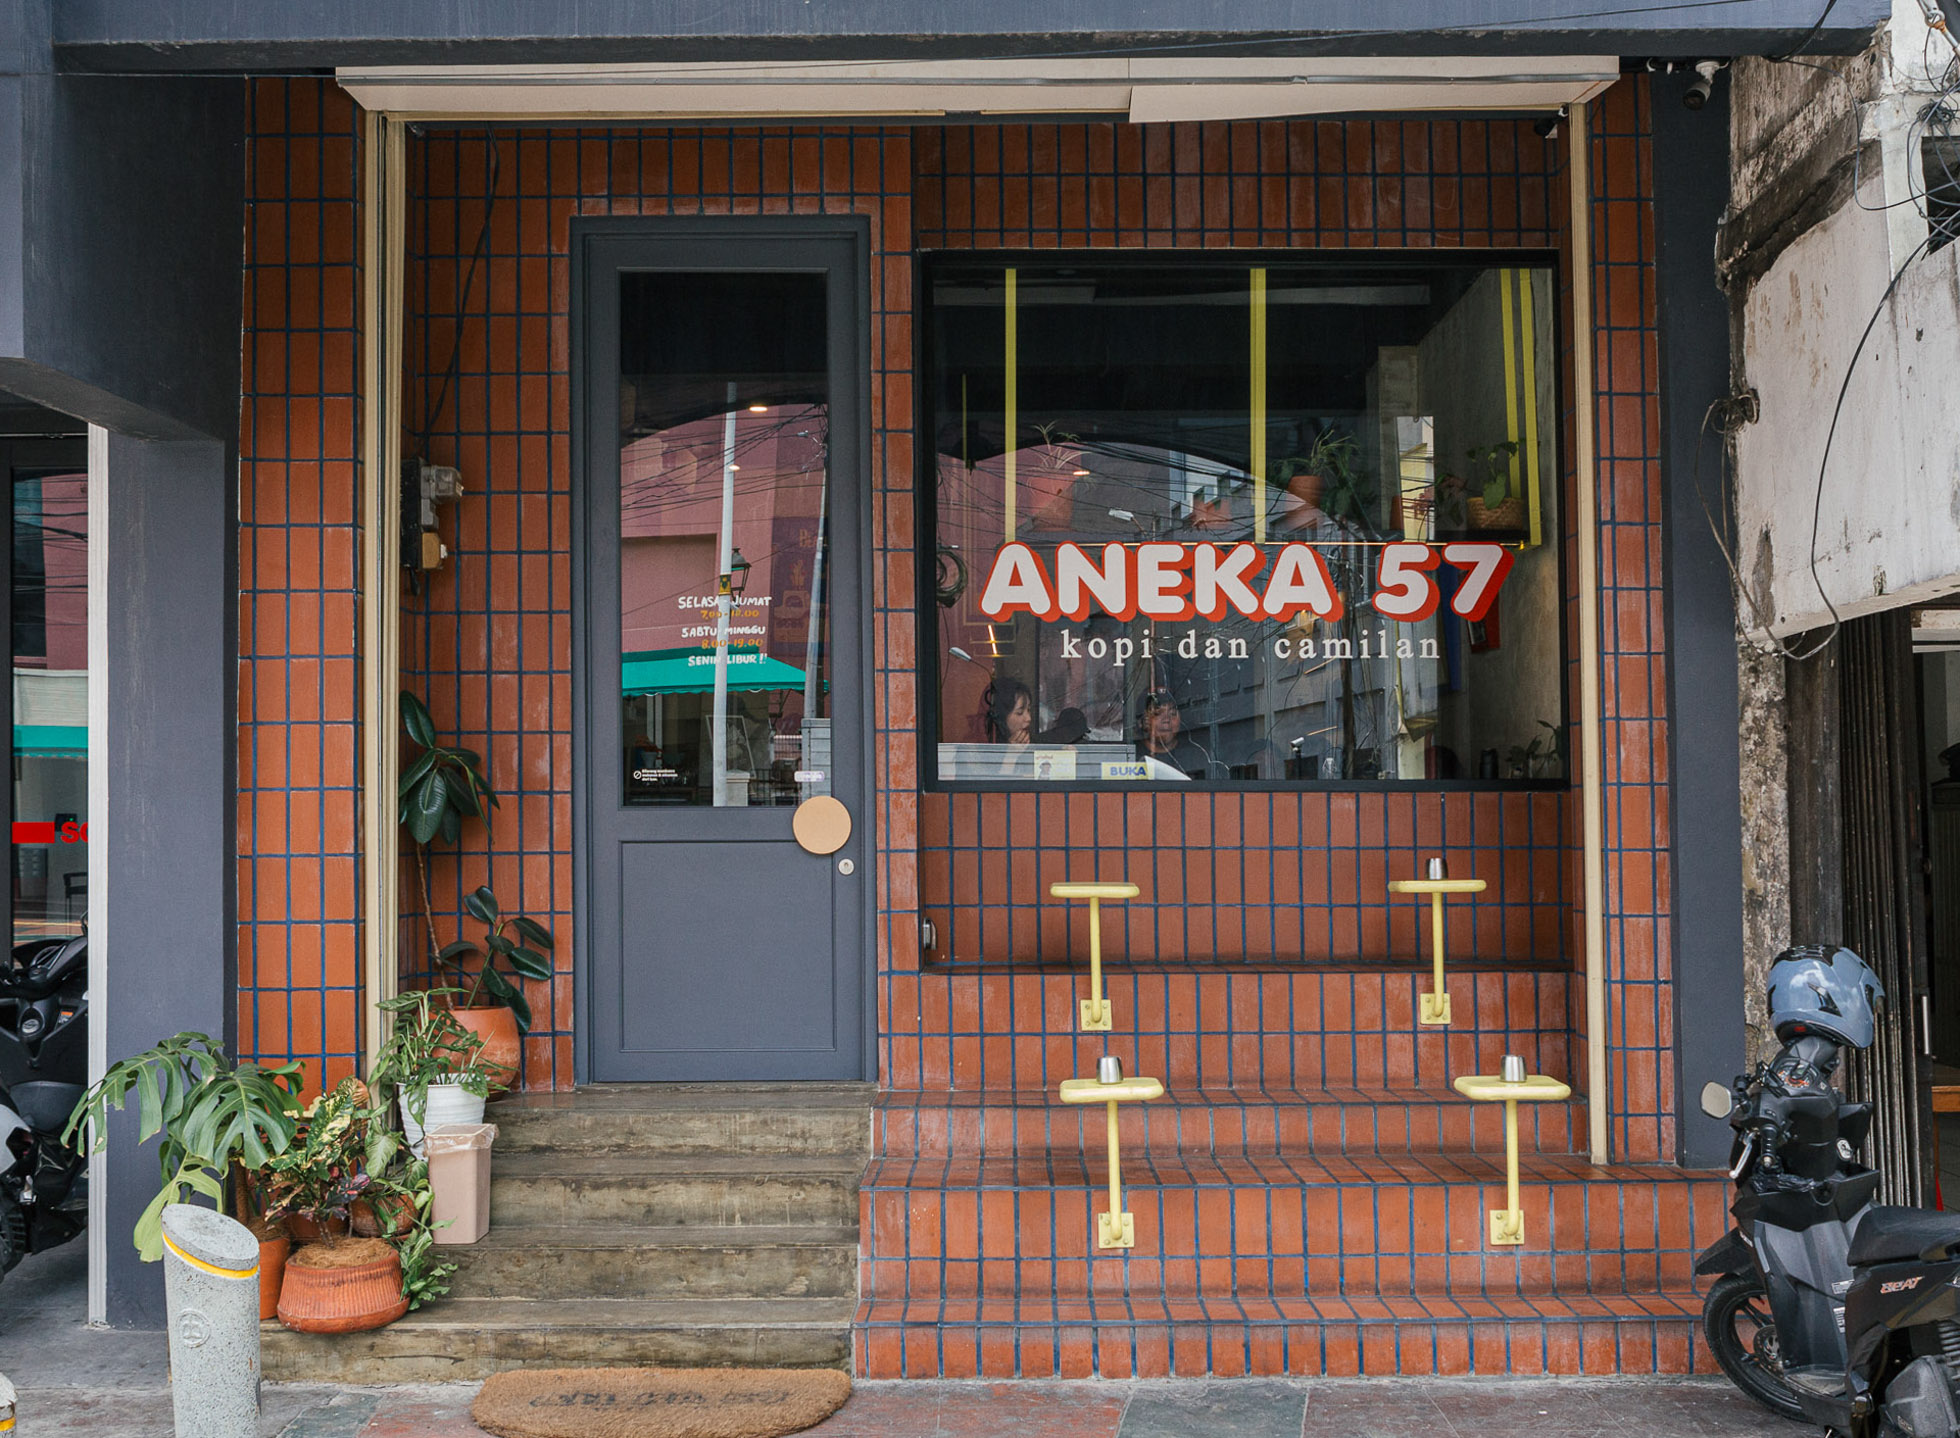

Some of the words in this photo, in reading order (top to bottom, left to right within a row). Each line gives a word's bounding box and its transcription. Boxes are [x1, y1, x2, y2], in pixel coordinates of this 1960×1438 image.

[979, 541, 1344, 623] ANEKA
[1372, 541, 1515, 623] 57
[731, 595, 772, 607] JUMAT
[681, 626, 718, 638] SABTU
[724, 625, 766, 636] MINGGU
[1061, 629, 1152, 666] kopi
[1178, 629, 1249, 659] dan
[1274, 630, 1440, 659] camilan
[1110, 766, 1146, 776] BUKA
